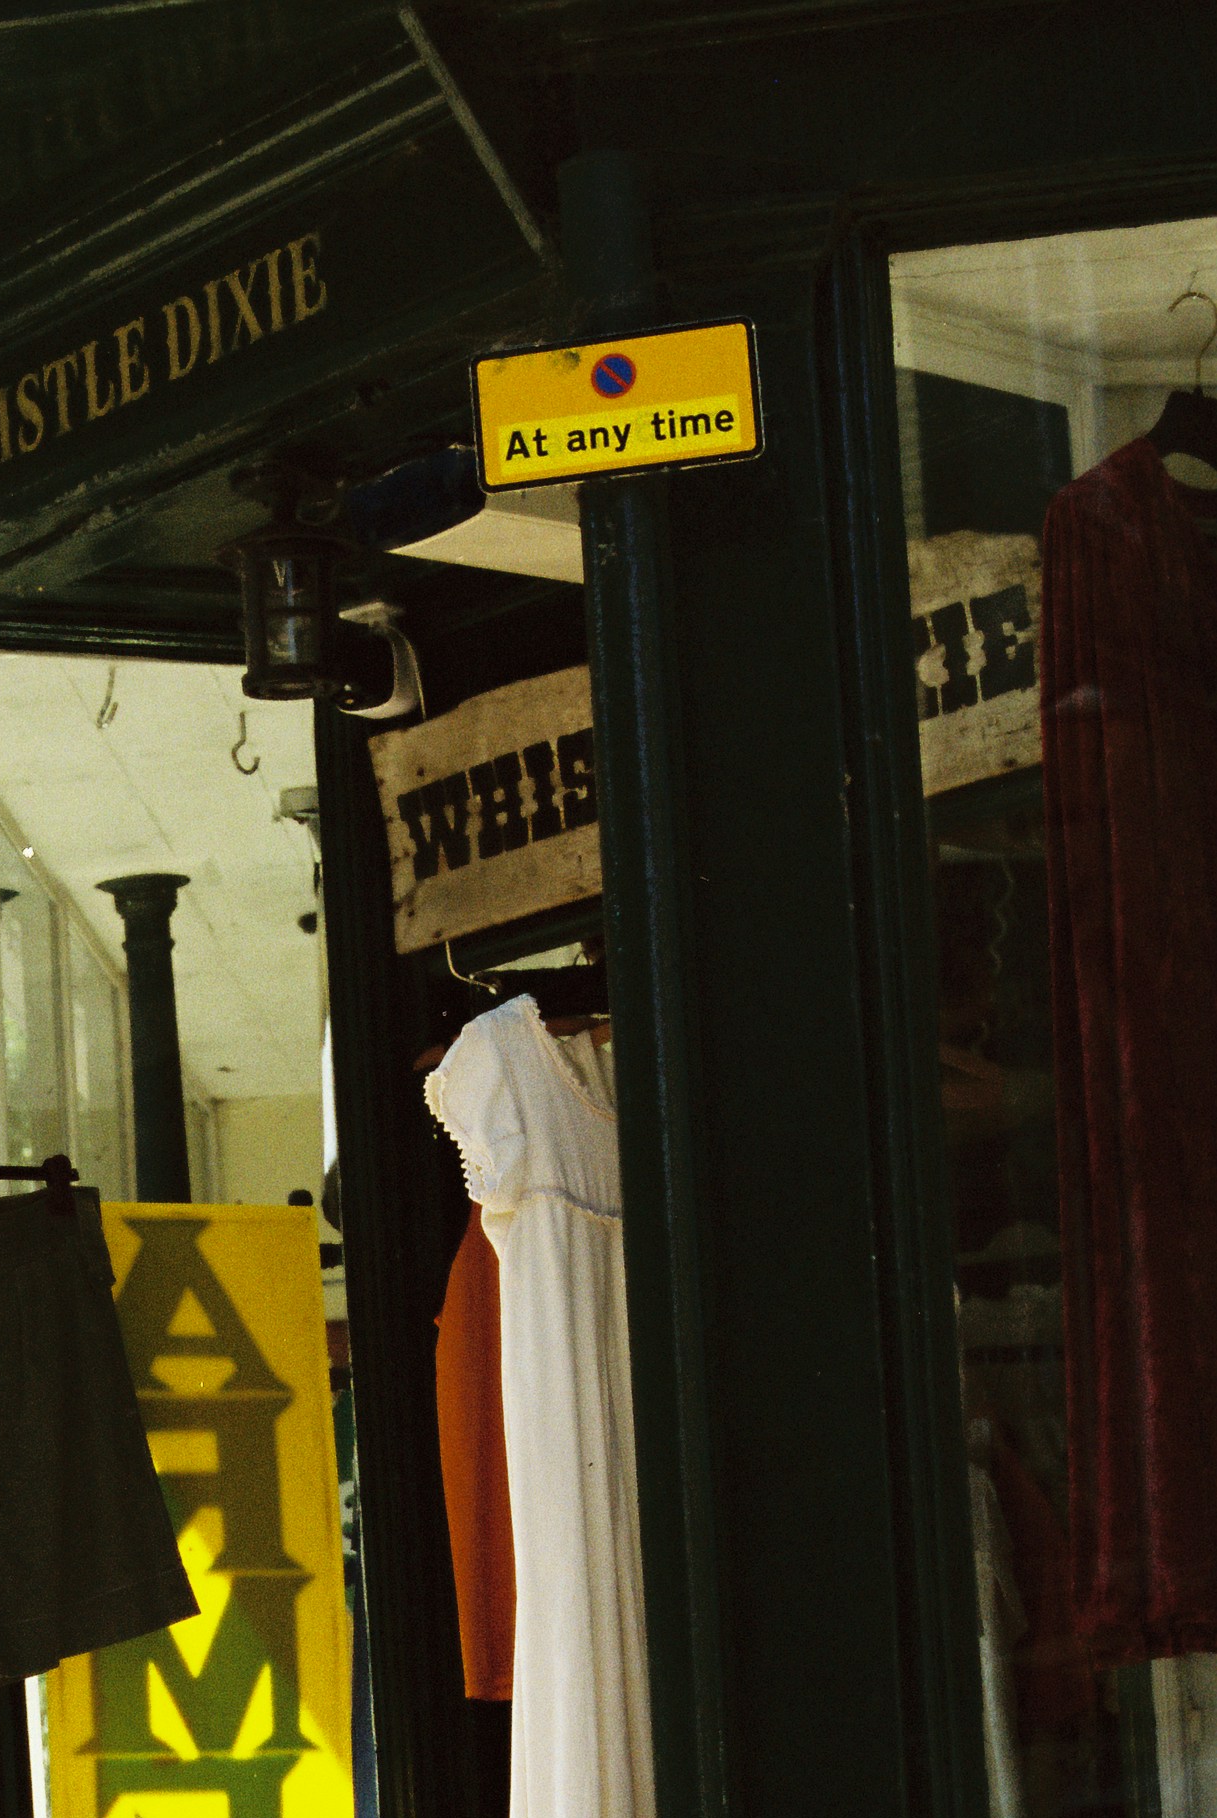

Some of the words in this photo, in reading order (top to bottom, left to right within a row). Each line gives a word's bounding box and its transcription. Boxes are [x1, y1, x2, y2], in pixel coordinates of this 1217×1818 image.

[162, 232, 327, 381] DIXIE
[505, 429, 548, 461] At
[567, 423, 631, 453] any
[651, 409, 734, 441] time
[397, 727, 599, 882] WHIS
[912, 583, 1035, 717] IE
